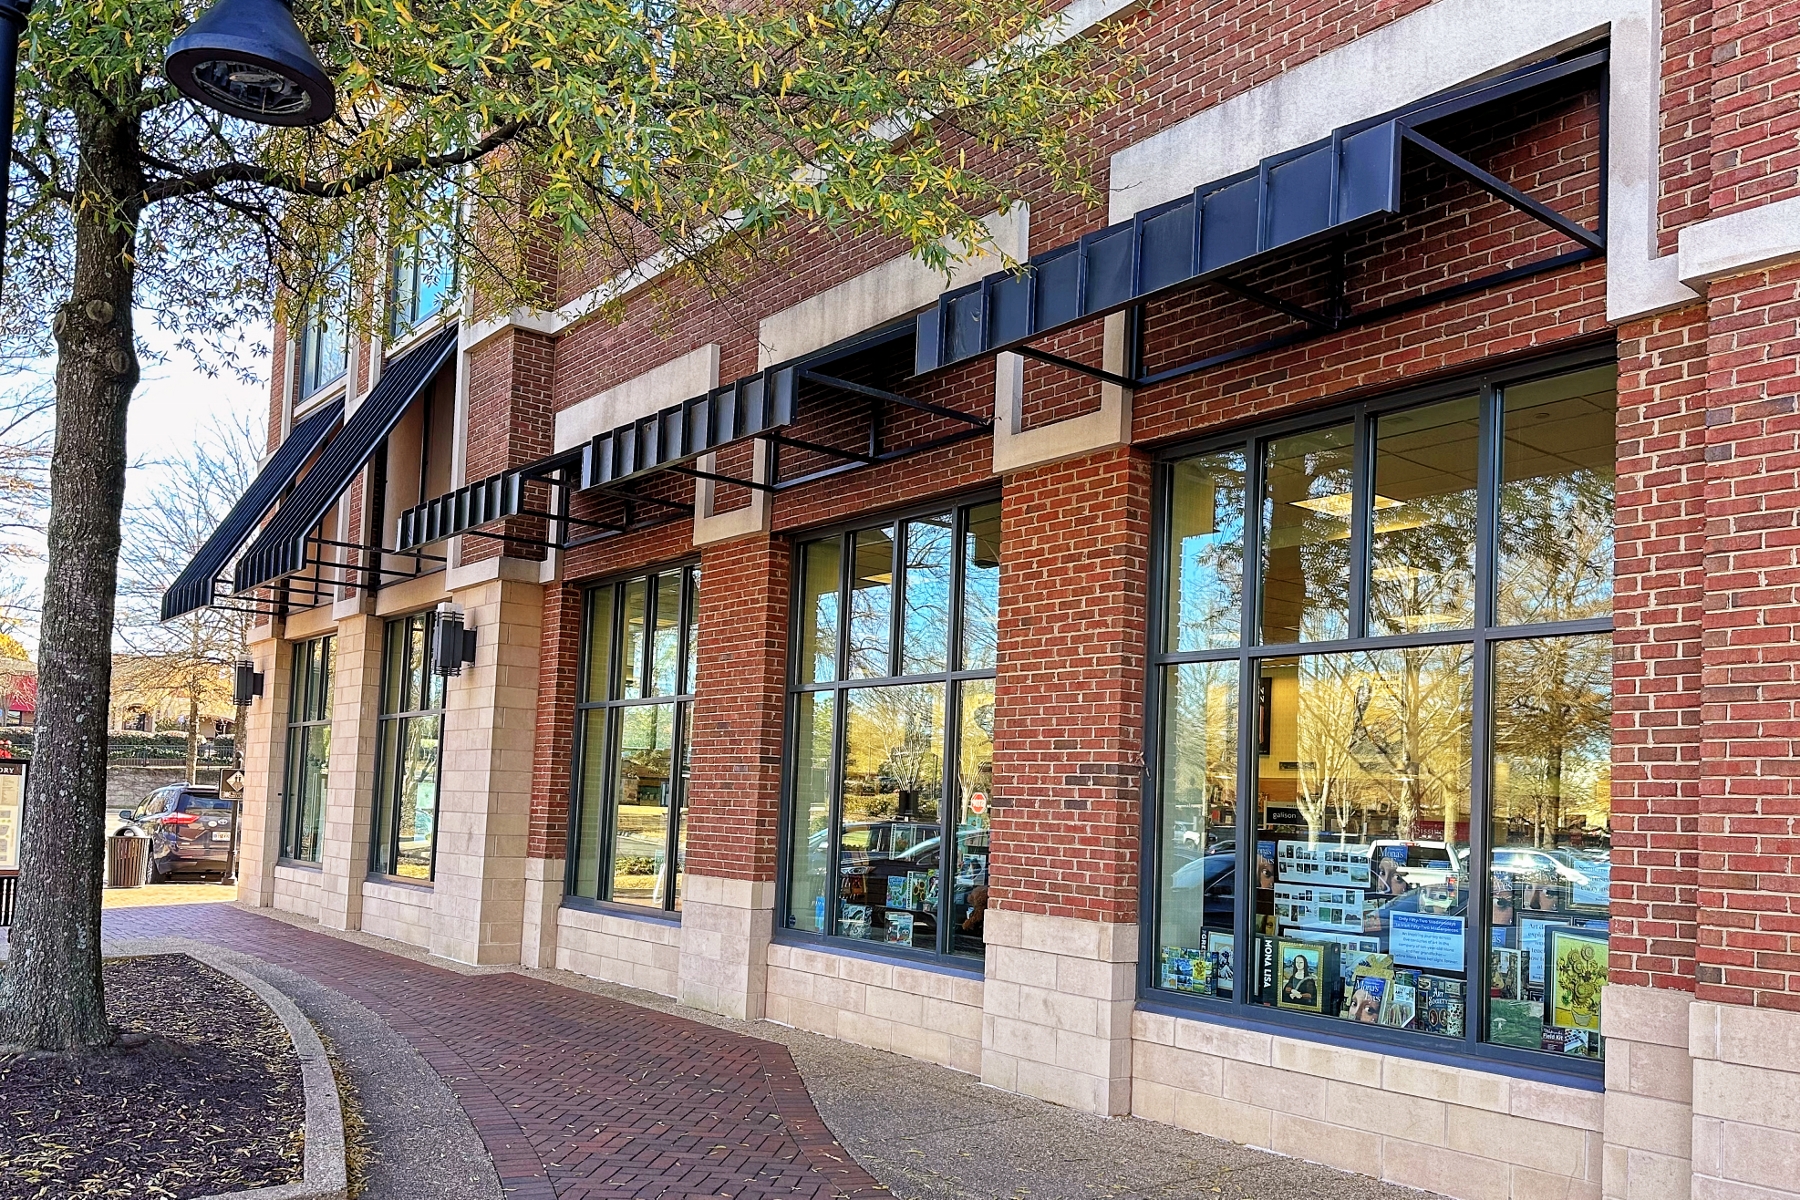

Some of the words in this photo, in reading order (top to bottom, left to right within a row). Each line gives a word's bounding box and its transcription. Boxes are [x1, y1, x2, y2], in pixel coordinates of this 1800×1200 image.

[1272, 812, 1297, 820] galison
[1264, 940, 1273, 967] MONA
[1263, 968, 1272, 988] LISA
